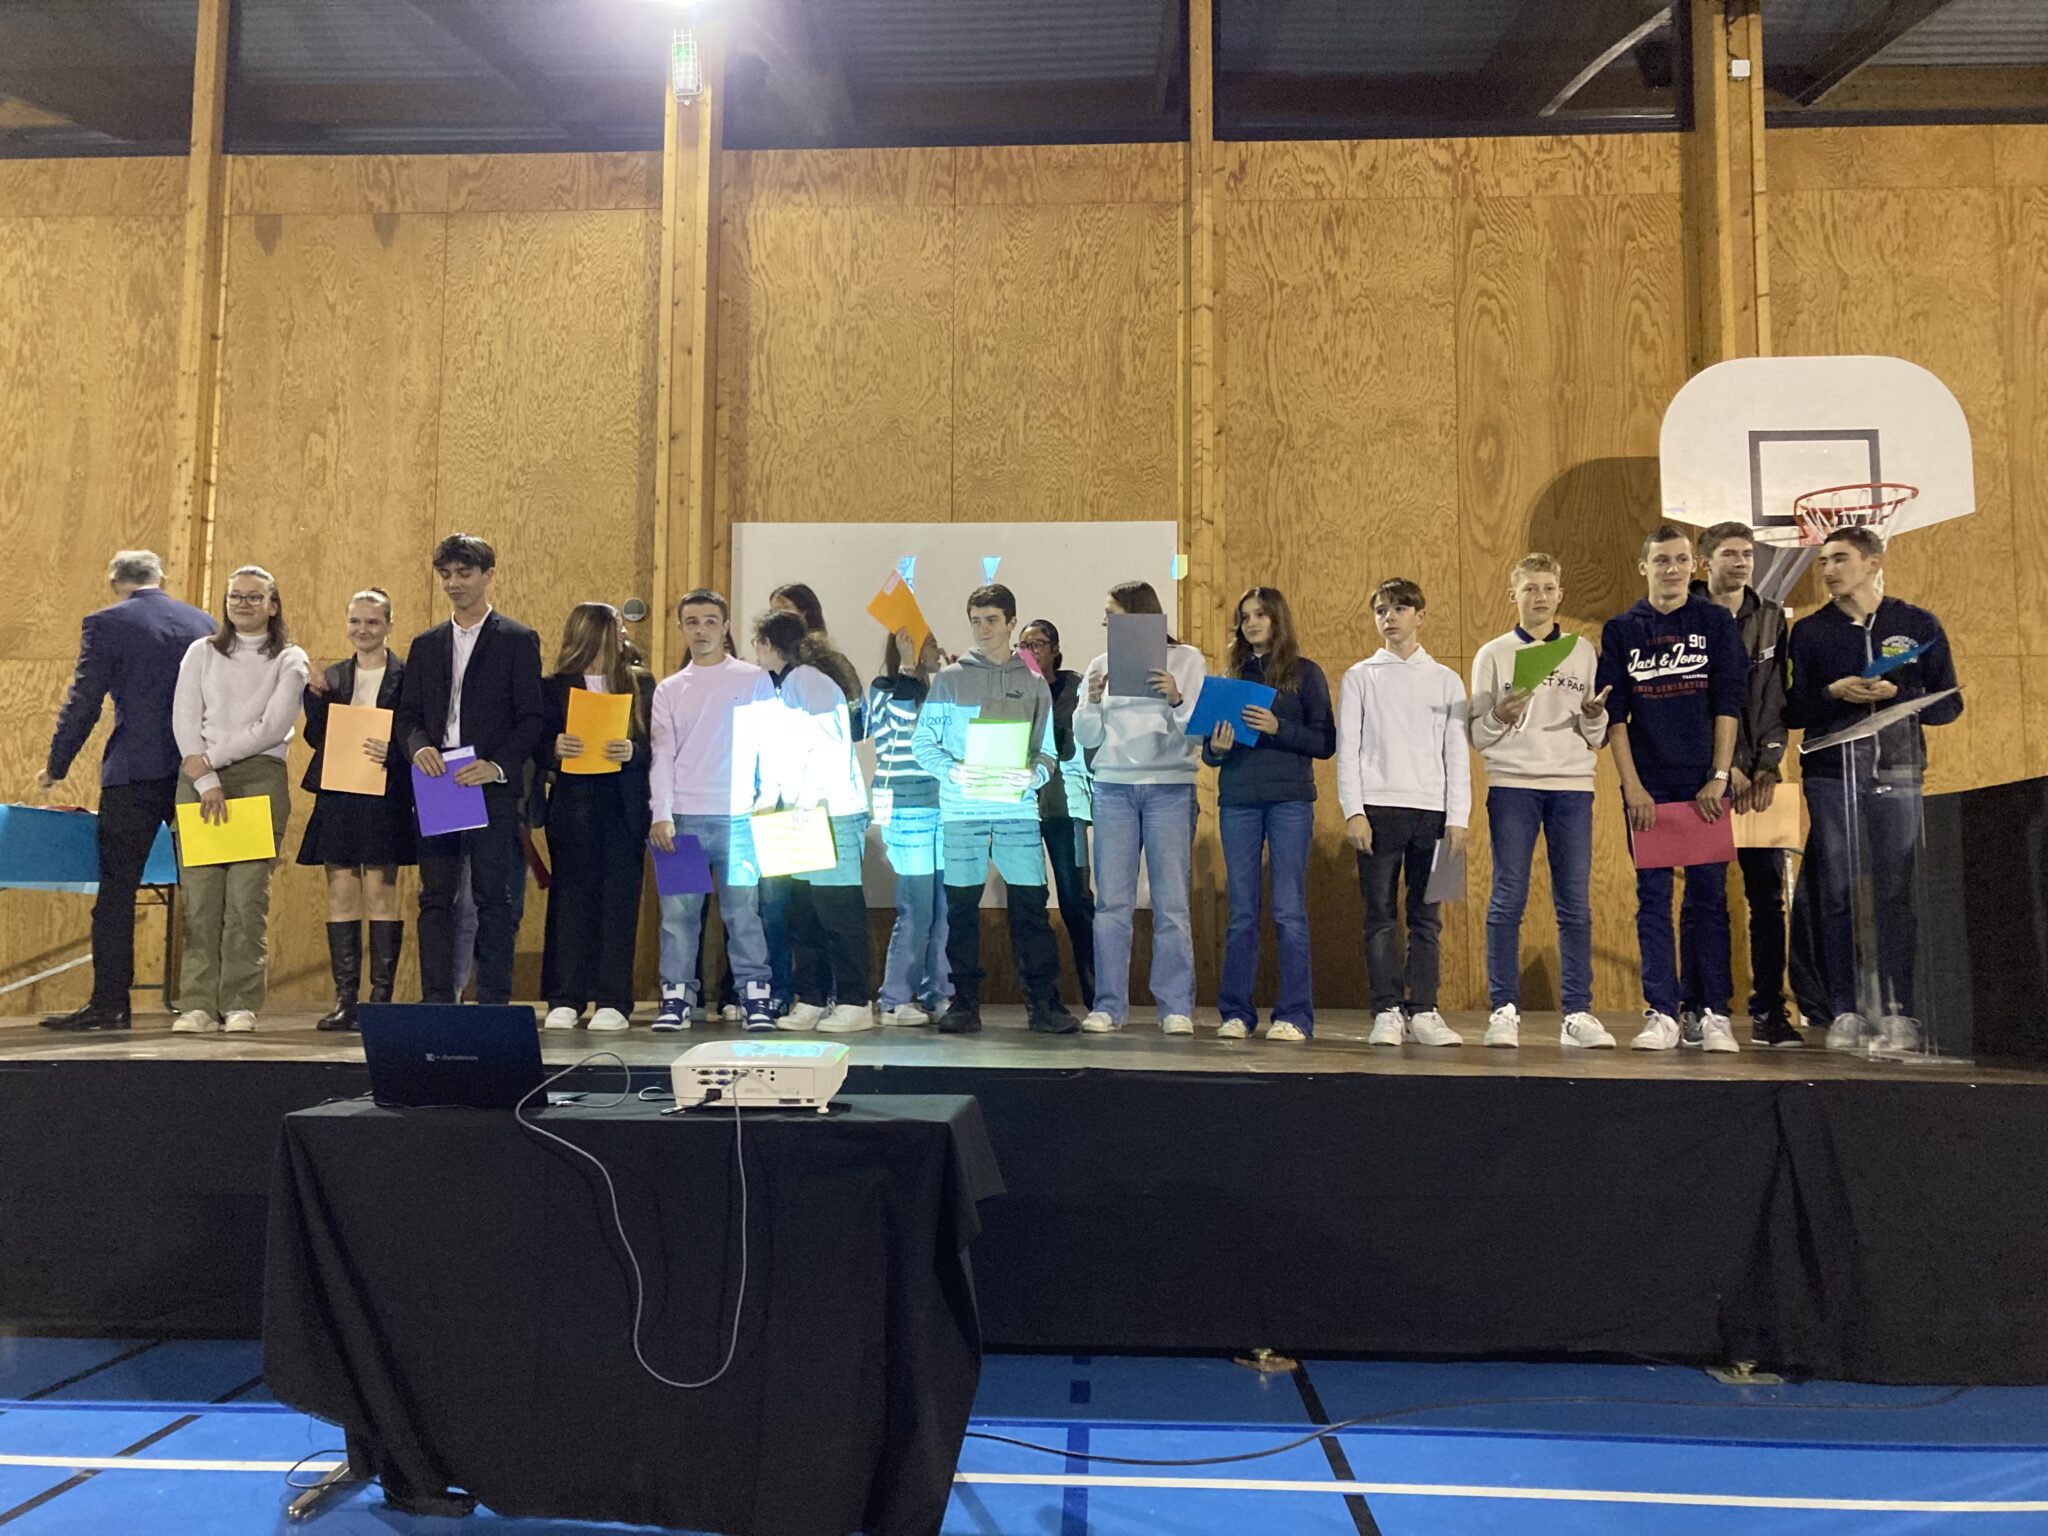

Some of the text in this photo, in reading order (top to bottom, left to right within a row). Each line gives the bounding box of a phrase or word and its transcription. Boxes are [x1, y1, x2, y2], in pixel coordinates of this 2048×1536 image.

[1688, 633, 1707, 650] 90
[1627, 642, 1708, 673] Jack & Jones
[1557, 678, 1566, 687] X
